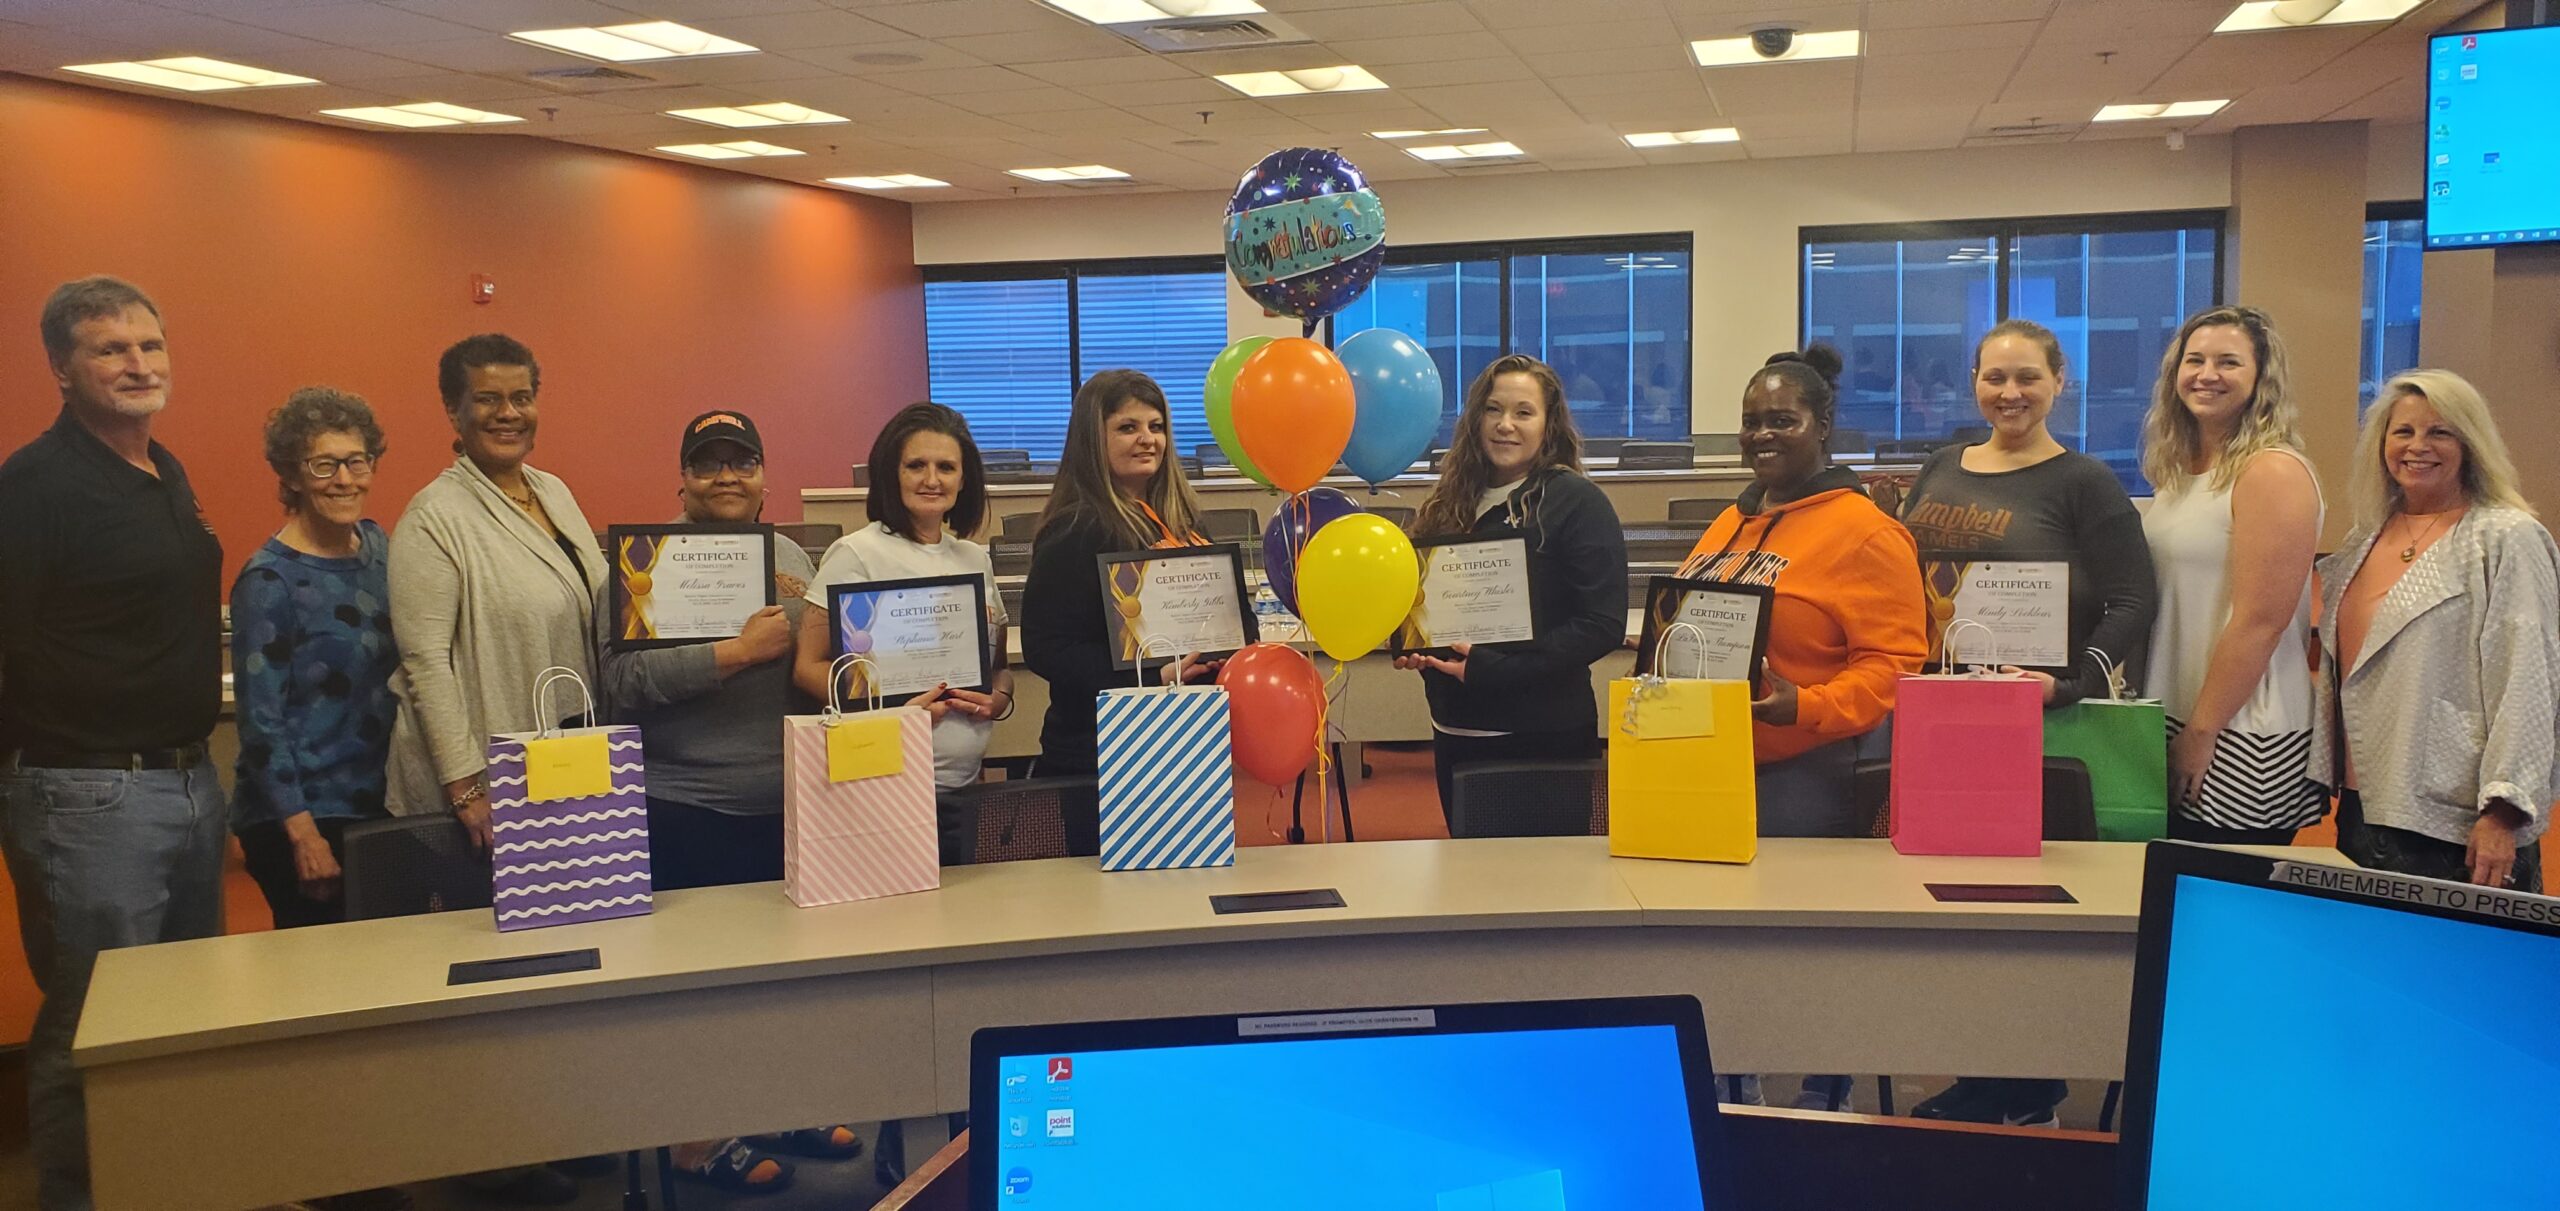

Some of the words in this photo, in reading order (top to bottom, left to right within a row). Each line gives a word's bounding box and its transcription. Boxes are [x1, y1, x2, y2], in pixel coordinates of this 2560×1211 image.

[1233, 214, 1357, 272] Congratulations
[672, 552, 749, 562] CERTIFICATE
[1441, 558, 1512, 573] CERTIFICATE
[1155, 571, 1222, 585] CERTIFICATE
[1975, 580, 2053, 590] CERTIFICATE
[890, 603, 962, 618] CERTIFICATE
[1690, 608, 1748, 622] CERTIFICATE
[2287, 865, 2425, 903] REMEMBER
[2432, 886, 2467, 909] TO
[2475, 893, 2560, 925] PRESS
[1049, 1115, 1072, 1126] point
[1009, 1176, 1030, 1184] zoom
